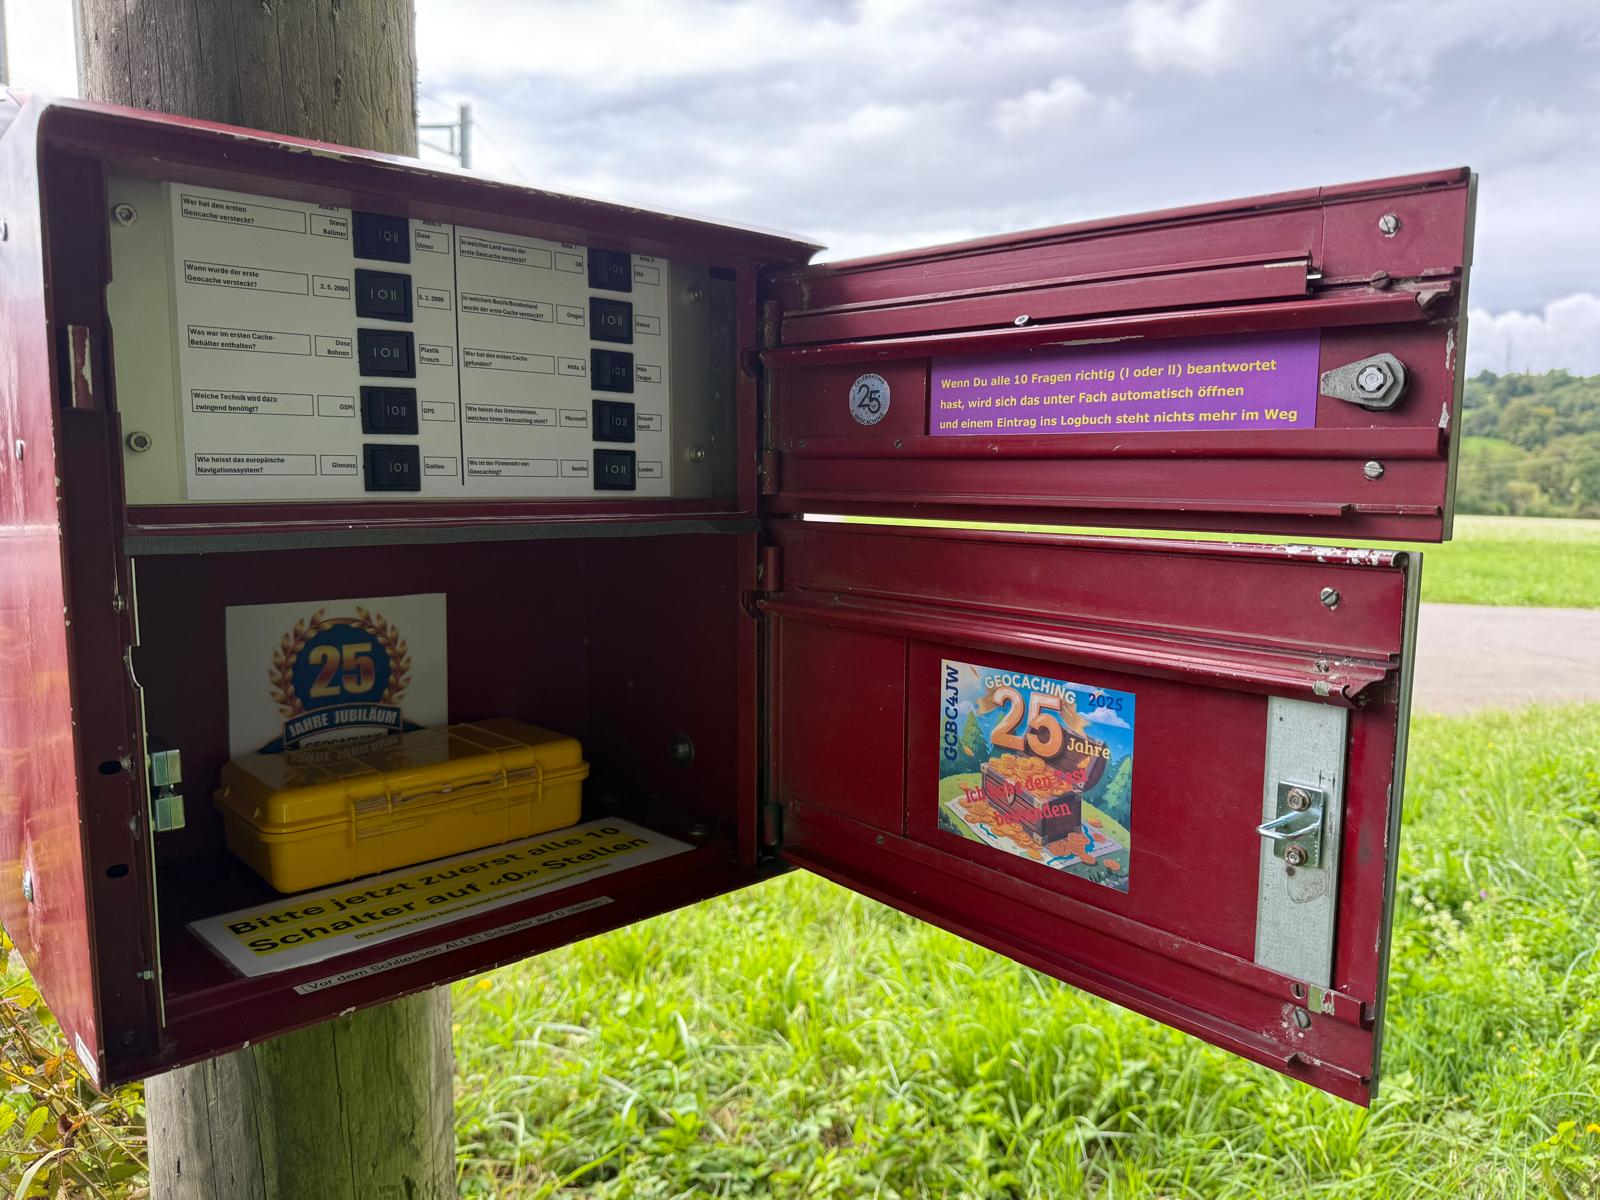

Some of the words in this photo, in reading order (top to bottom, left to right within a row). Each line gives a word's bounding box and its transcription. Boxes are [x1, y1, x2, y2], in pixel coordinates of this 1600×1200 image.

[182, 198, 198, 206] Wer
[198, 200, 210, 208] hat
[211, 201, 224, 210] den
[226, 204, 247, 213] ersten
[184, 208, 218, 219] Geocache
[220, 214, 254, 224] versteckt?
[323, 228, 346, 237] Ballmer
[186, 264, 206, 272] Wann
[208, 267, 228, 275] wurde
[187, 274, 221, 284] Geocache
[222, 278, 258, 288] versteckt?
[190, 328, 205, 336] Was
[230, 331, 251, 339] ersten
[190, 339, 220, 348] Behälter
[220, 341, 256, 350] enthalten?
[327, 348, 350, 356] Bohnen
[941, 379, 970, 390] Wenn
[973, 376, 988, 388] Du
[990, 375, 1010, 386] alle
[1014, 374, 1028, 385] 10
[1032, 372, 1072, 384] Fragen
[1076, 368, 1116, 381] richtig
[1133, 365, 1164, 378] oder
[1186, 360, 1277, 374] beantwortet
[192, 392, 219, 400] Welche
[220, 394, 246, 402] Technik
[858, 384, 881, 414] 25
[940, 399, 965, 410] hast,
[968, 397, 992, 408] wird
[995, 396, 1017, 407] sich
[1020, 395, 1040, 406] das
[1043, 393, 1076, 405] unter
[1078, 391, 1108, 404] Fach
[1111, 386, 1194, 402] automatisch
[1198, 386, 1244, 398] öffnen
[195, 404, 227, 412] zwingend
[228, 404, 258, 414] benötigt?
[940, 419, 958, 429] und
[960, 418, 994, 428] einem
[996, 416, 1036, 429] Eintrag
[1040, 416, 1058, 426] ins
[1060, 413, 1112, 428] Logbuch
[1115, 412, 1150, 424] steht
[1154, 410, 1194, 423] nichts
[1199, 410, 1238, 421] mehr
[1241, 409, 1260, 421] im
[1264, 408, 1298, 422] Weg
[211, 456, 232, 464] heisst
[232, 456, 245, 464] das
[246, 456, 286, 465] europäische
[197, 466, 264, 475] Navigationssystem?
[308, 642, 377, 699] 25
[984, 674, 1077, 705] GEOCACHING
[1088, 693, 1124, 712] 2025
[944, 665, 959, 761] GCBC4JW
[288, 712, 330, 738] JAHRE
[334, 706, 398, 725] JUBILÄUM
[991, 686, 1064, 758] 25
[1066, 737, 1111, 759] Jahre
[964, 786, 987, 803] Ich
[228, 906, 326, 935] Bitte
[329, 882, 416, 911] jetzt
[418, 853, 523, 886] zuerst
[527, 838, 583, 856] alle
[585, 827, 620, 839] 10
[248, 902, 416, 952] Schalter
[426, 882, 480, 904] auf
[541, 838, 649, 870] Stellen
[337, 967, 369, 981] dem
